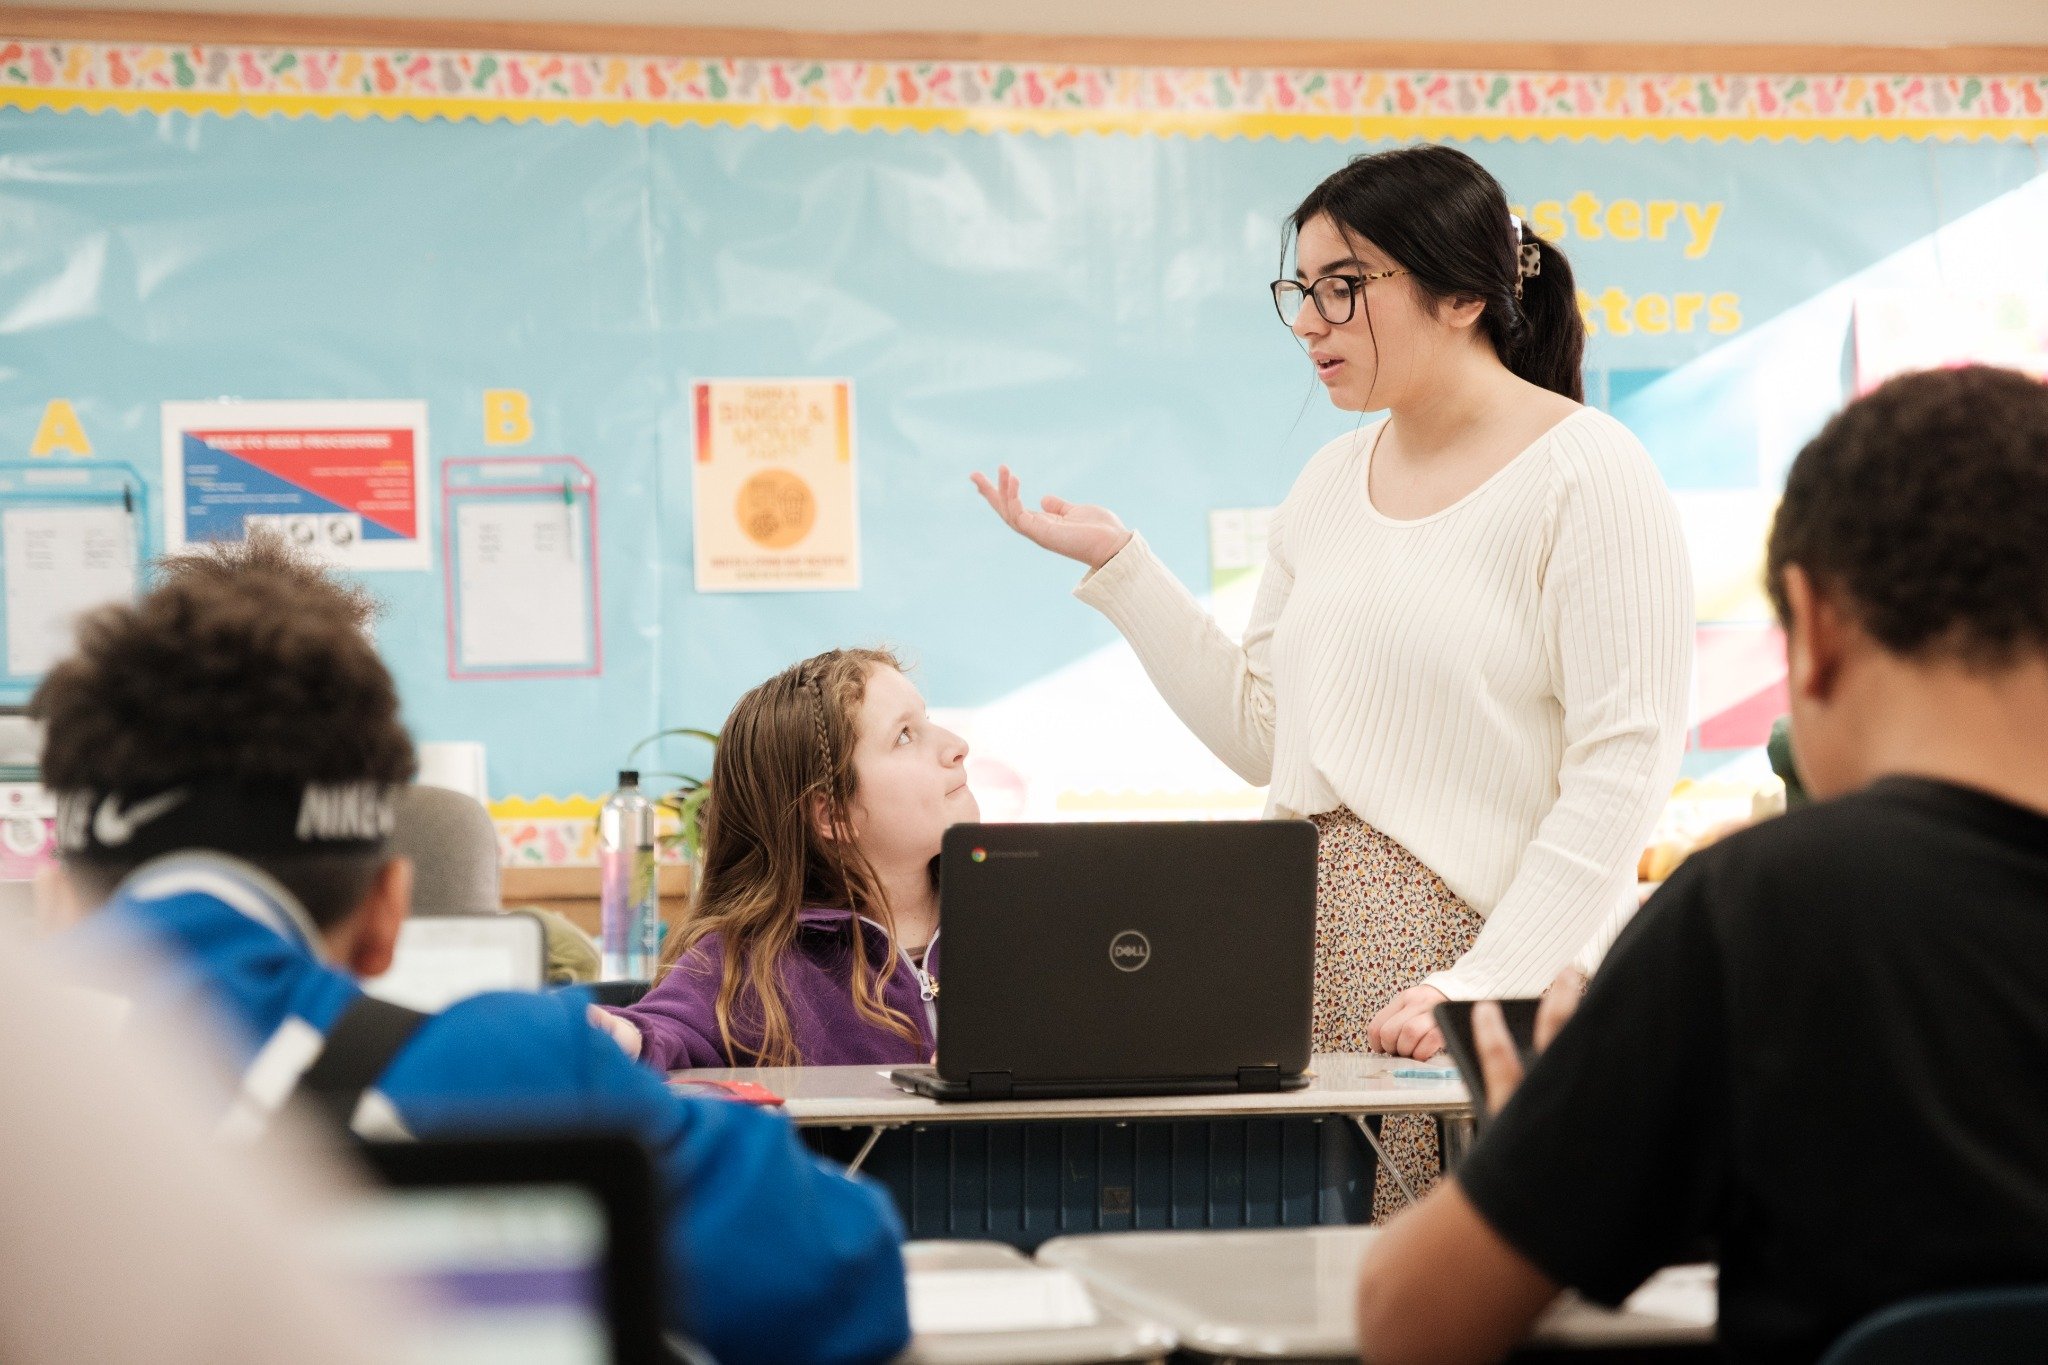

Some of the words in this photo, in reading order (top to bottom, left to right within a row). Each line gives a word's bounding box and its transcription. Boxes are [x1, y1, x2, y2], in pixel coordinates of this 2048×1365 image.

[1511, 190, 1724, 260] stery
[30, 398, 93, 457] A
[483, 388, 533, 445] B
[1115, 946, 1146, 957] DELL
